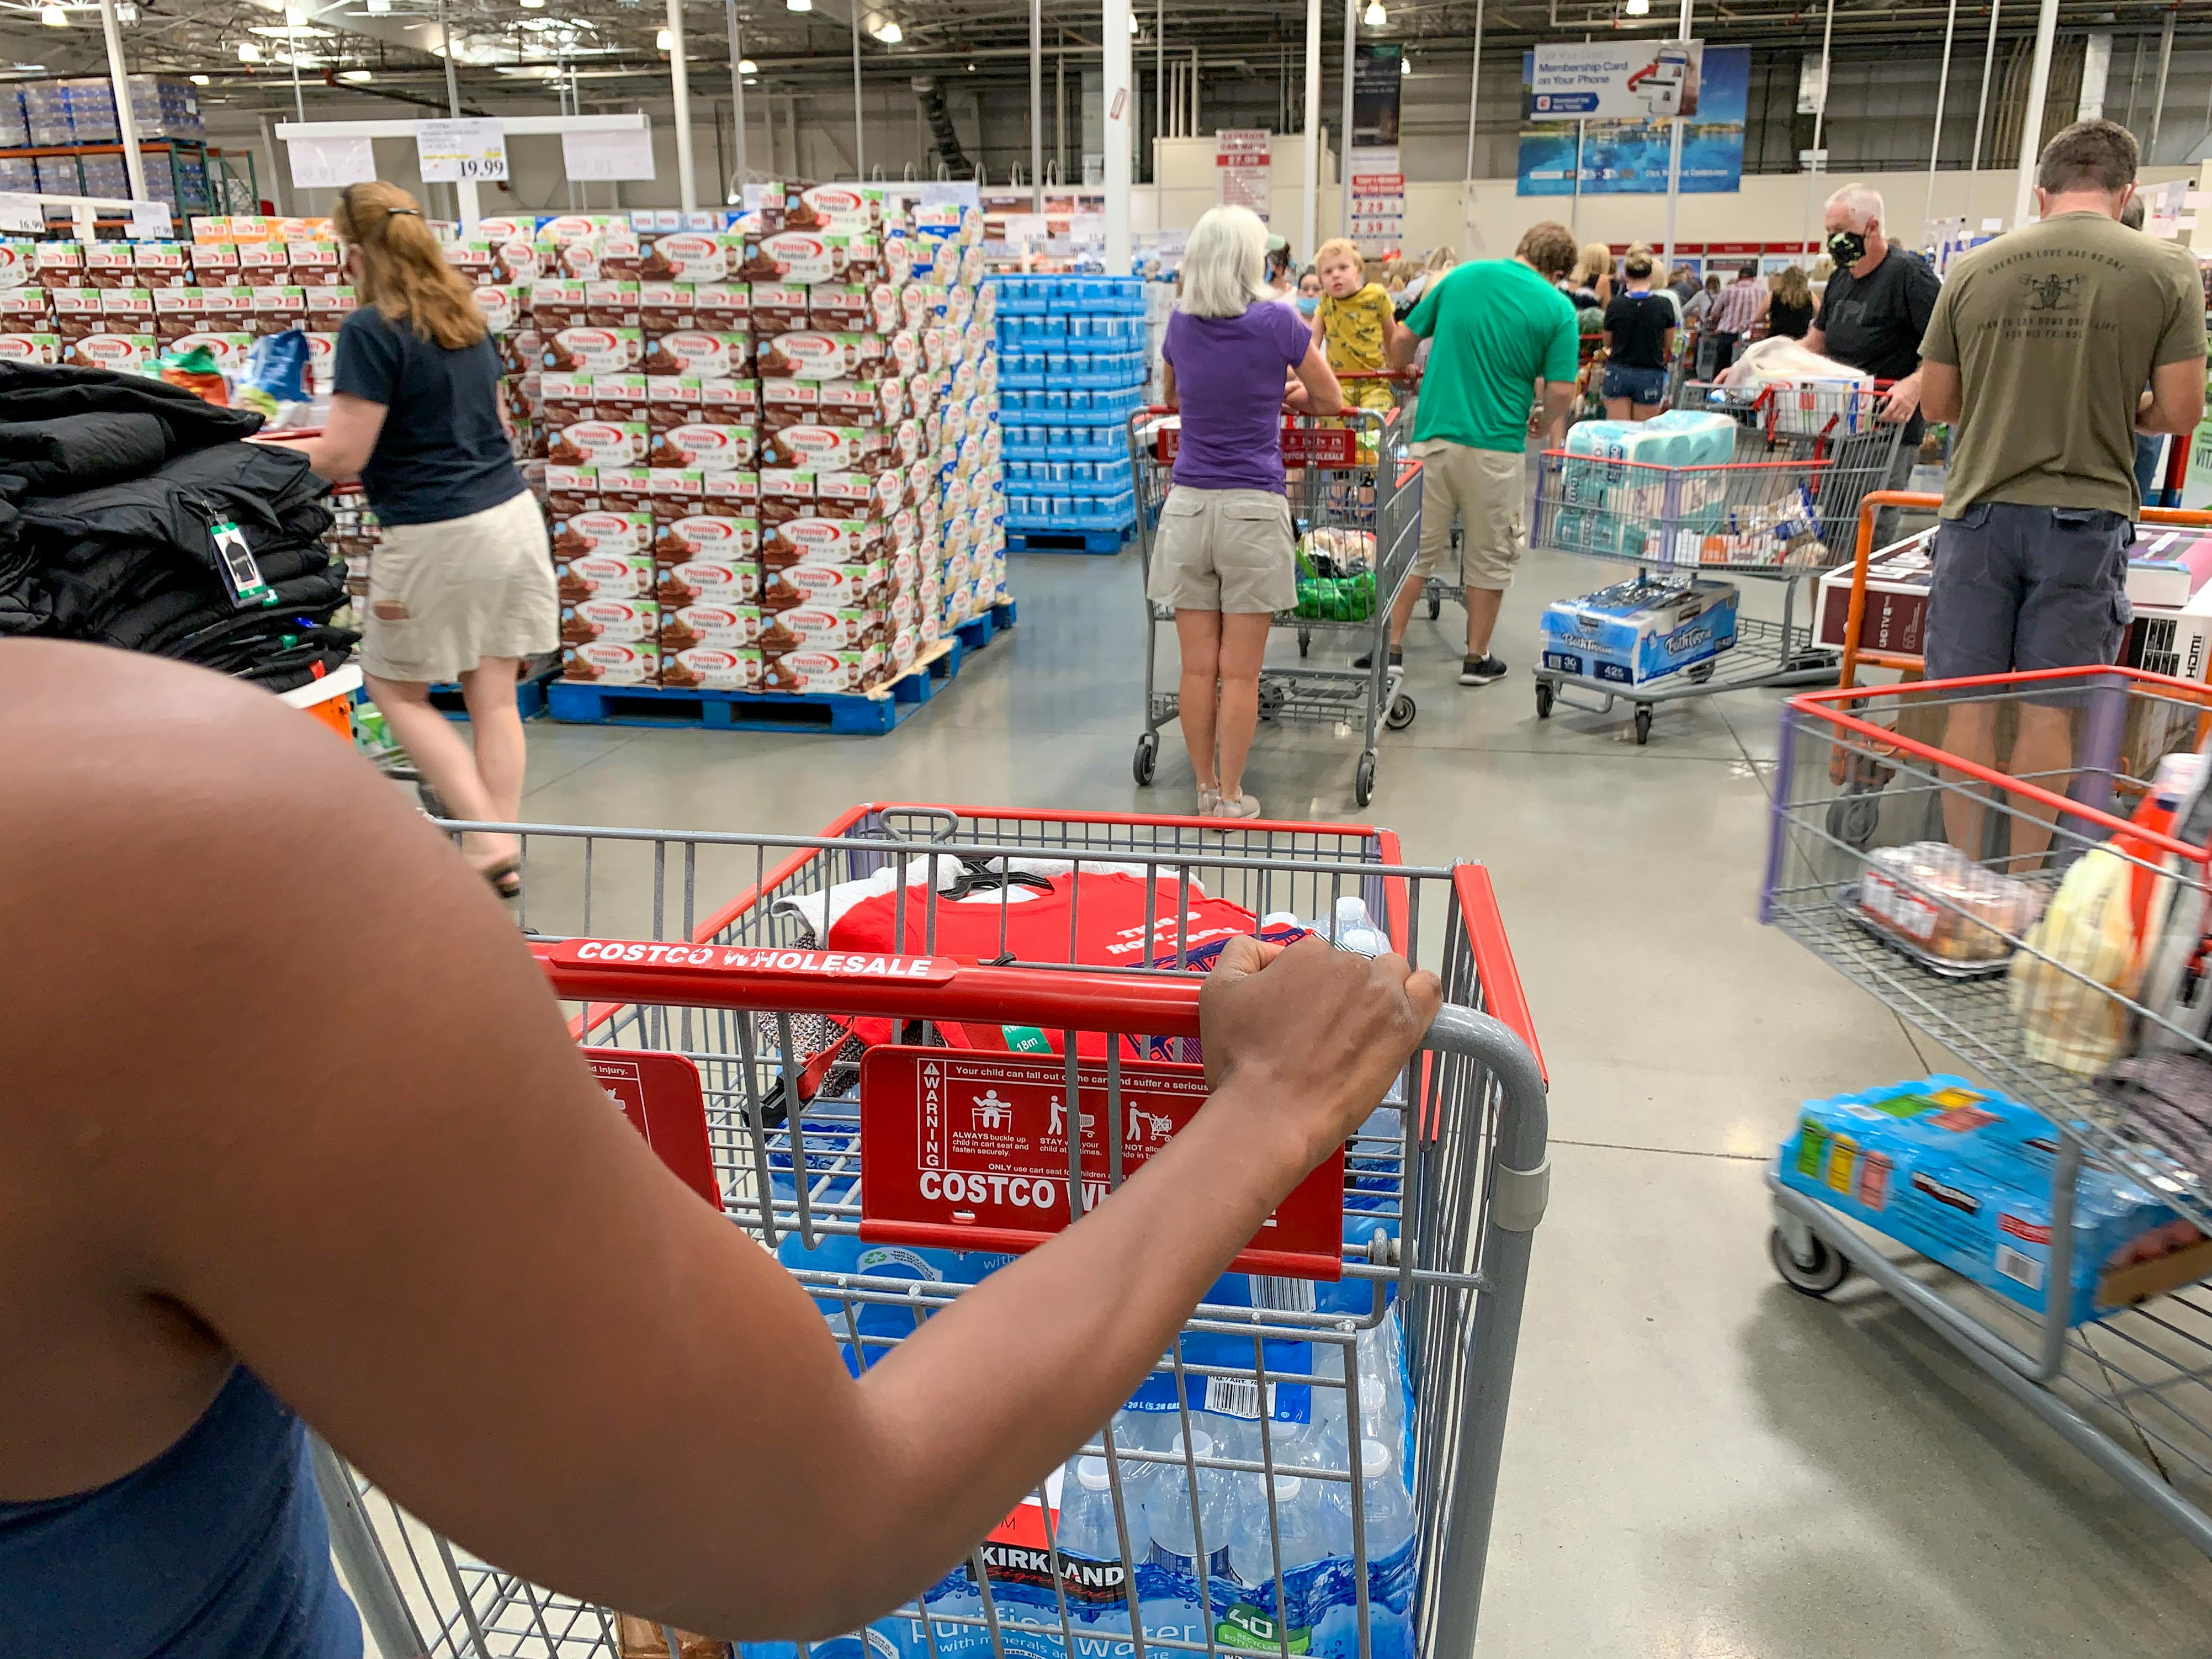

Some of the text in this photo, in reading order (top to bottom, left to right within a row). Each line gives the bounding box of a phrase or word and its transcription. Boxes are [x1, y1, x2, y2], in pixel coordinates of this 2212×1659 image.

[1539, 61, 1628, 73] Membership Card
[1553, 75, 1574, 85] Your
[1577, 75, 1610, 83] Phone
[460, 160, 503, 177] 19.99
[1988, 251, 2032, 275] GREATER
[2037, 249, 2062, 259] LOVE
[2066, 250, 2087, 259] HAS
[88, 342, 121, 352] Premier
[575, 429, 611, 438] Premier
[678, 432, 715, 442] Premier
[791, 432, 828, 442] Premier
[580, 520, 616, 529] Premier
[683, 523, 720, 533] Premier
[791, 526, 829, 536] Premier
[581, 562, 616, 571] Premier
[685, 568, 720, 578] Premier
[794, 571, 831, 581] Premier
[587, 606, 622, 616] Premier
[688, 612, 725, 622] Premier
[788, 614, 826, 624] Premier
[588, 648, 623, 658] Premier
[689, 654, 725, 664] Premier
[792, 656, 829, 666] Premier
[577, 941, 933, 977] COSTCO WHOLESALE
[1016, 1037, 1038, 1052] 18m
[599, 1066, 628, 1075] injury.
[956, 1066, 979, 1075] Your
[981, 1068, 1004, 1077] child
[1026, 1070, 1041, 1079] fall
[1043, 1073, 1059, 1081] out
[1133, 1079, 1161, 1088] suffer
[1173, 1082, 1209, 1091] serious
[924, 1077, 940, 1167] WARNING
[953, 1131, 989, 1140] ALWAYS
[990, 1133, 1014, 1142] buckle
[1040, 1137, 1063, 1146] STAY
[953, 1146, 1011, 1157] fasten securely.
[1125, 1144, 1143, 1152] NOT
[989, 1164, 1011, 1172] ONLY
[1081, 1170, 1106, 1179] hildren
[920, 1170, 1055, 1209] COSTCO
[1128, 1401, 1138, 1409] 20
[1229, 1608, 1273, 1639] 40
[940, 1634, 975, 1652] with
[977, 1635, 1047, 1653] mnerals
